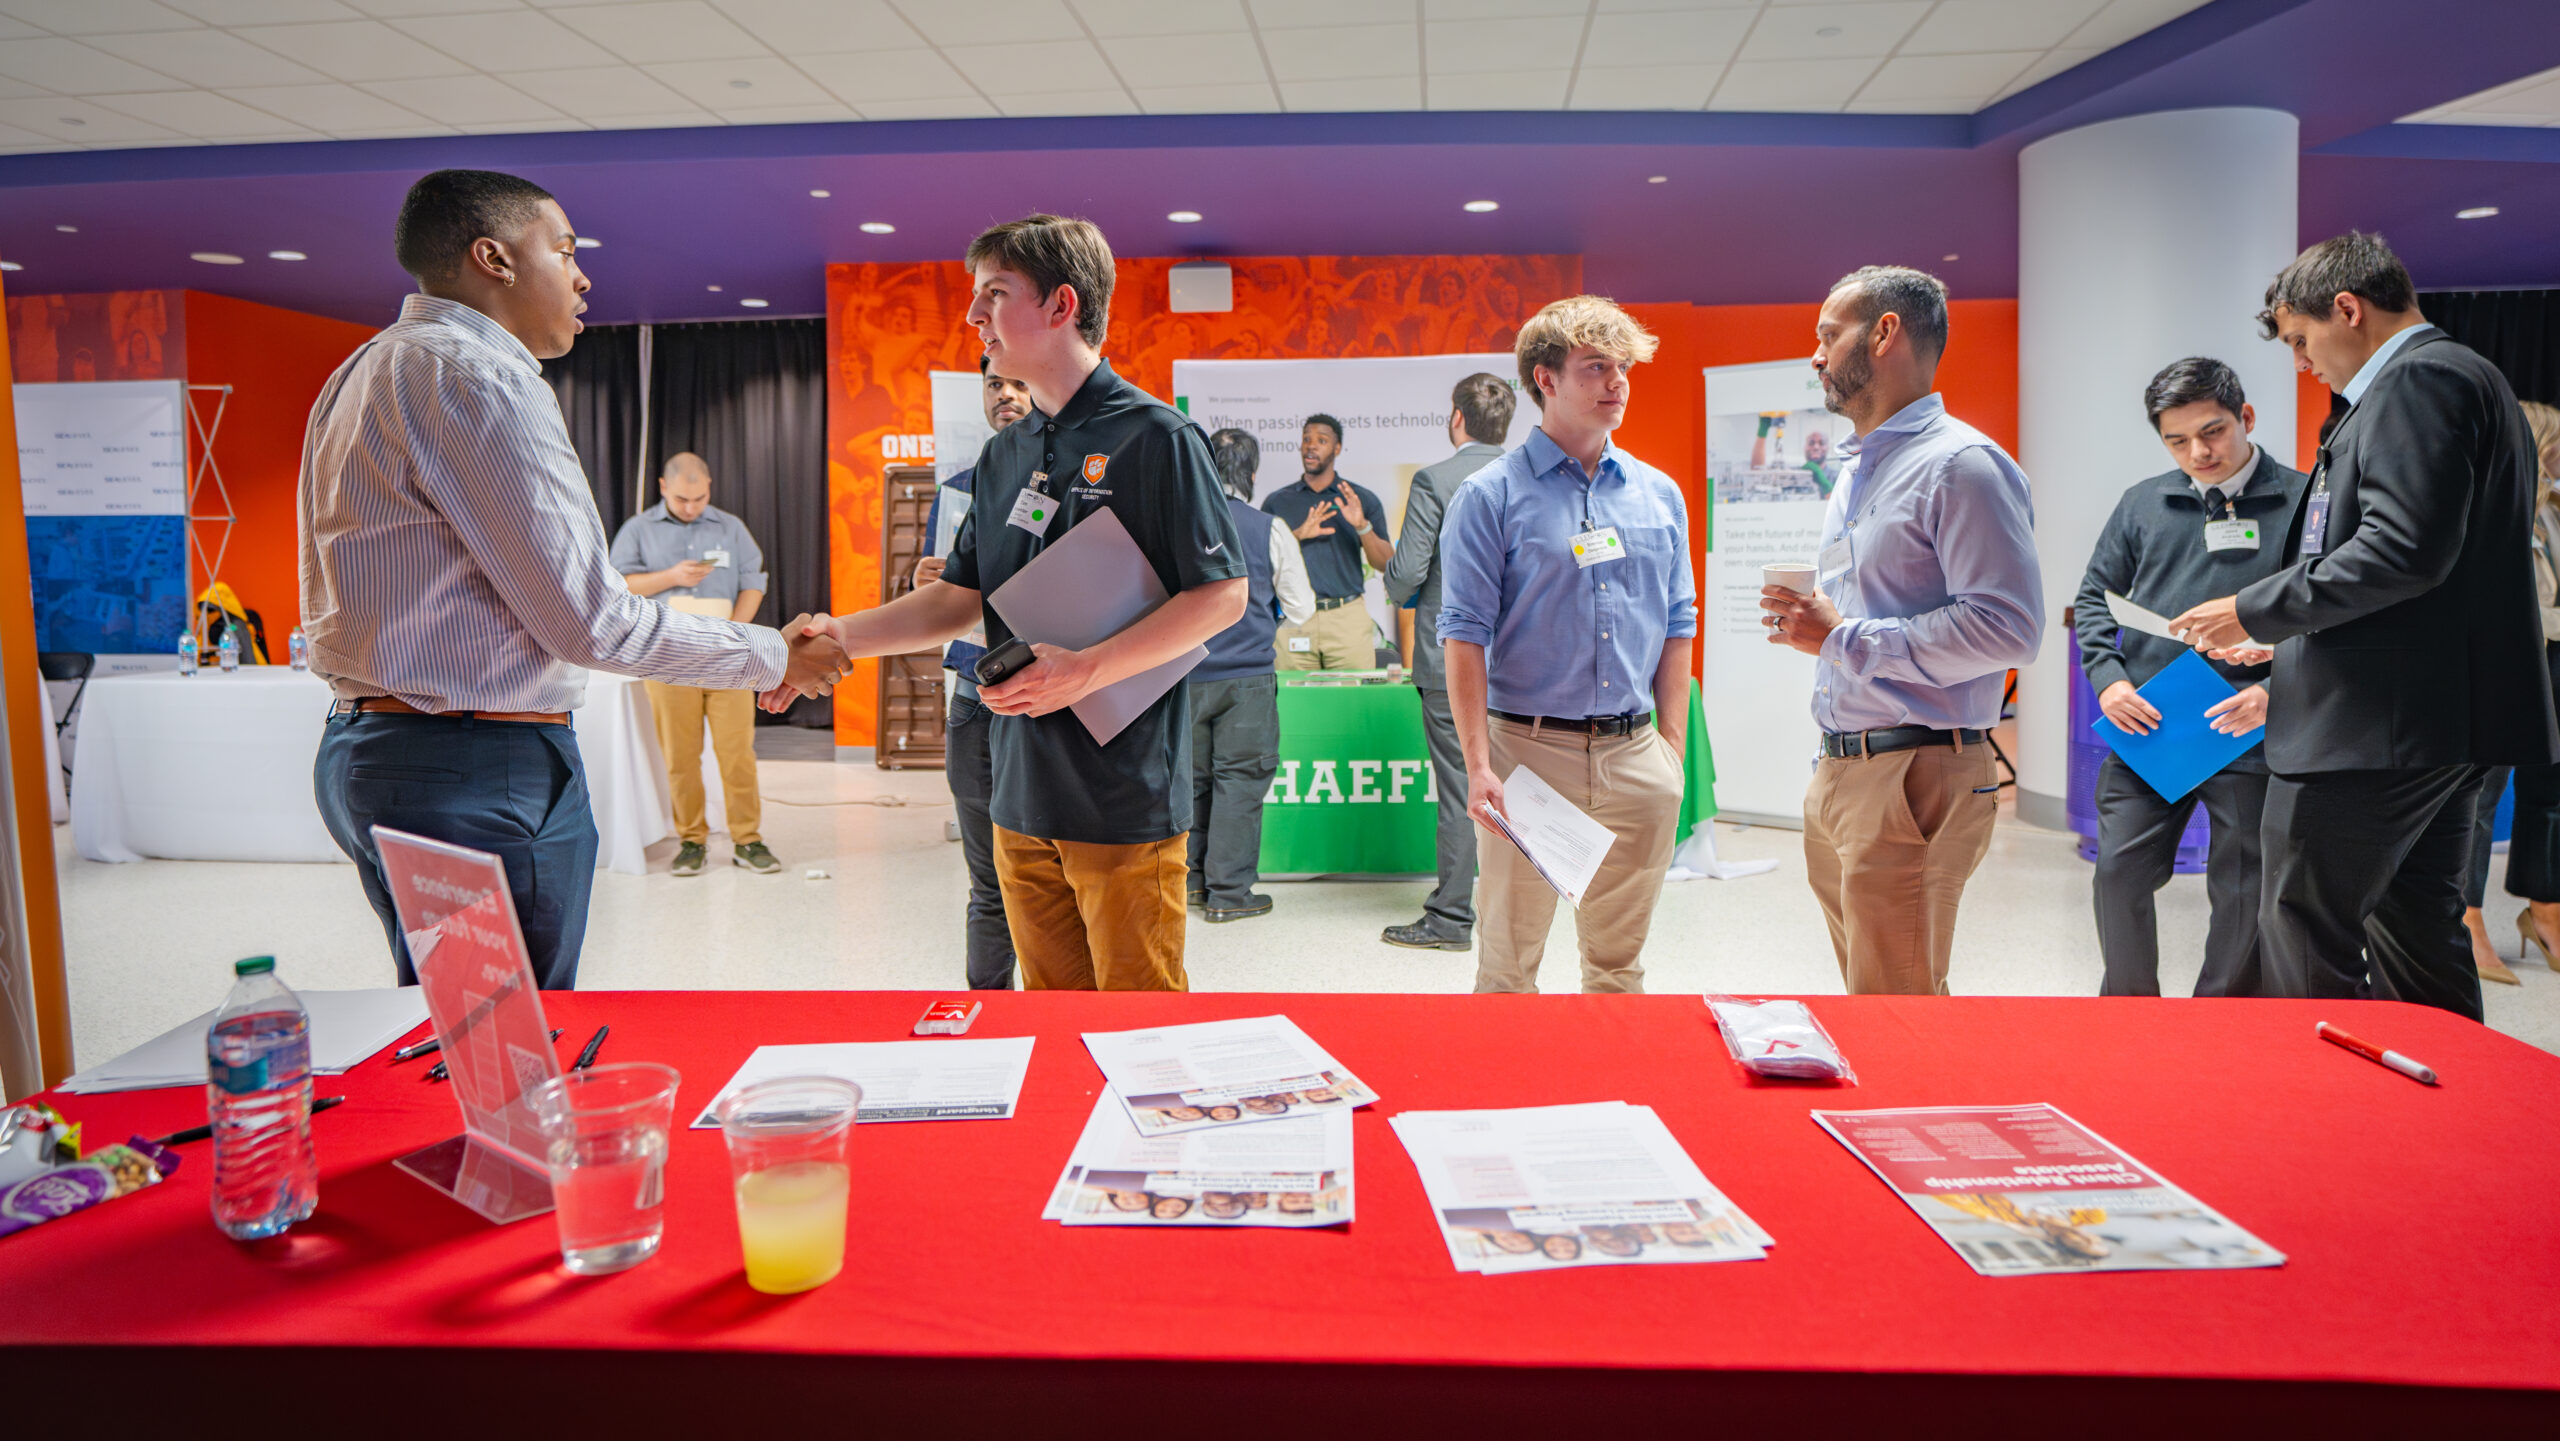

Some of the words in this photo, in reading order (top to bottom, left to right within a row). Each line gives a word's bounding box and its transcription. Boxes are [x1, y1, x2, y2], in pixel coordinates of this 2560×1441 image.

[1209, 415, 1253, 430] When
[1258, 415, 1306, 431] passio
[1341, 415, 1371, 429] eets
[1376, 412, 1453, 429] technolog
[881, 434, 935, 458] ONE
[1748, 529, 1761, 539] the
[1764, 529, 1793, 538] future
[1795, 528, 1805, 538] of
[1725, 545, 1744, 555] your
[1780, 543, 1798, 553] And
[936, 1107, 999, 1116] Vanguard
[2012, 1162, 2126, 1175] Associate
[1924, 1174, 2070, 1189] Relationship
[2068, 1172, 2142, 1186] Client
